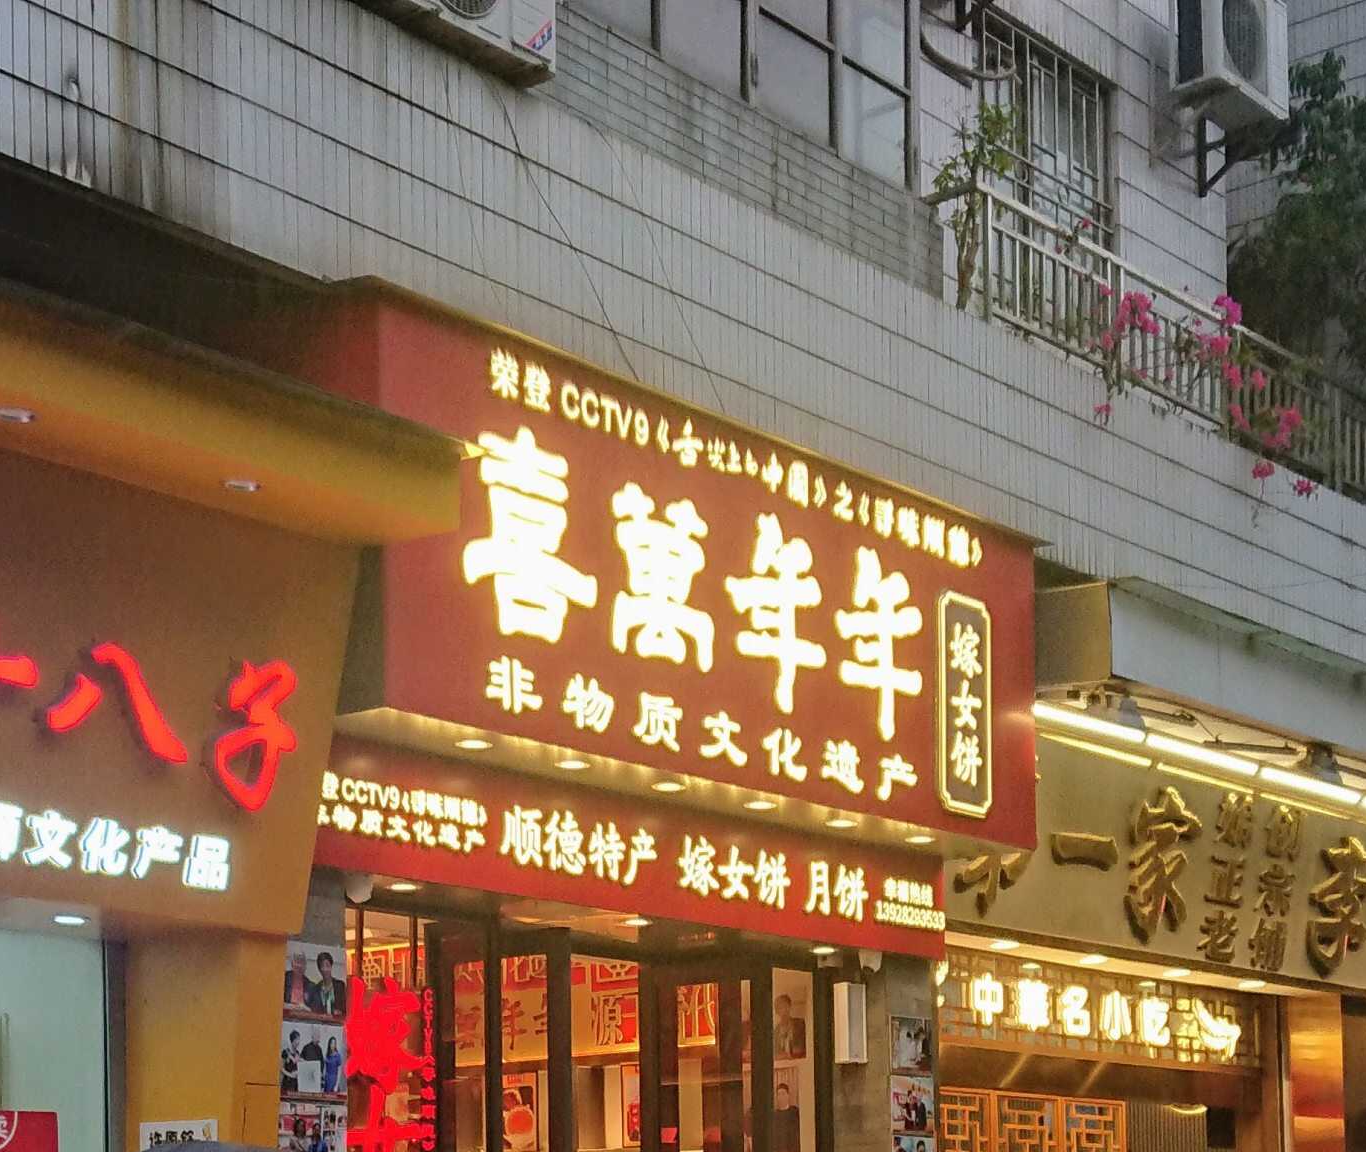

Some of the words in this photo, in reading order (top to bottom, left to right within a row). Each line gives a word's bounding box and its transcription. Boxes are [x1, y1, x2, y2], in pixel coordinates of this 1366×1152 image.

[486, 657, 919, 801] 非物质文化遗产
[948, 627, 983, 788] 嫁女饼
[500, 805, 659, 886] 顺德特产
[676, 834, 791, 910] 嫁女饼
[804, 860, 869, 922] 月饼
